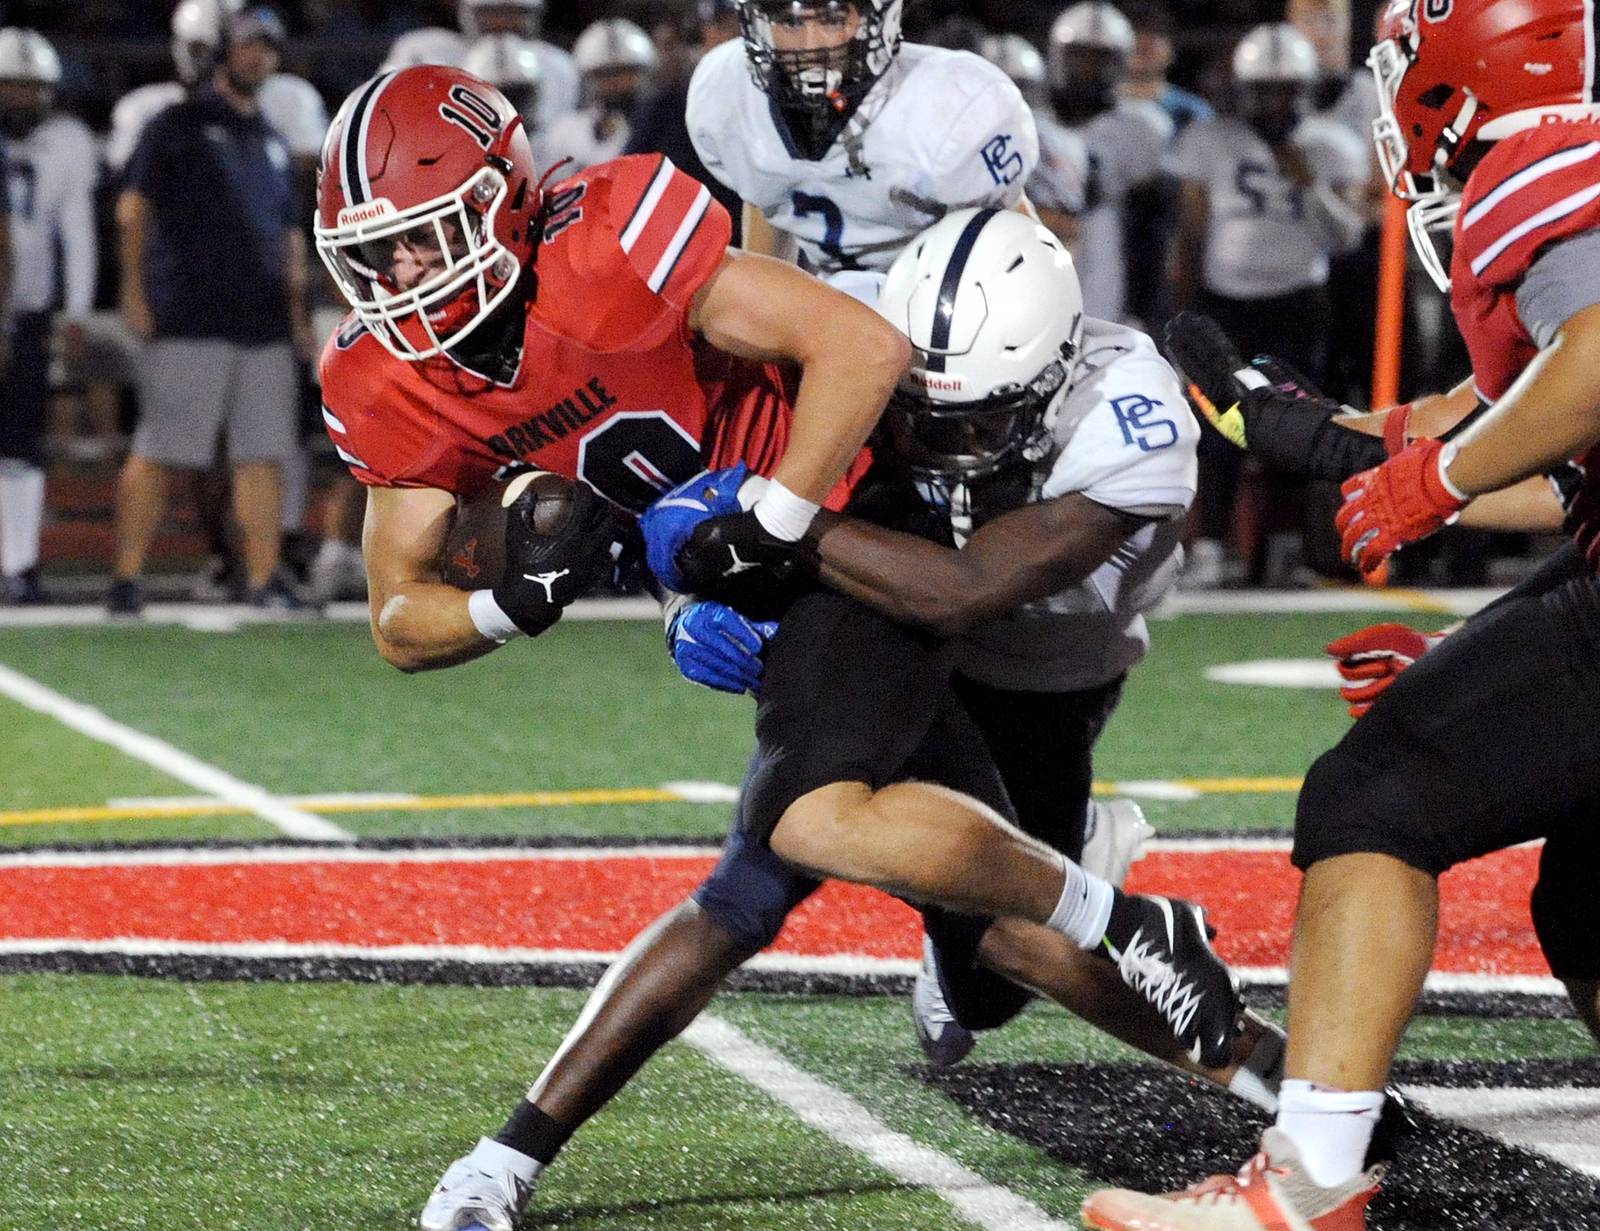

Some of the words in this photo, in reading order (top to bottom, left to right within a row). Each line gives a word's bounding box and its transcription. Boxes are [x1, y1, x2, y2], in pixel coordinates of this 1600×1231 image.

[438, 84, 502, 152] 10
[980, 134, 1024, 186] PS
[340, 203, 386, 225] Riddell
[487, 376, 618, 459] ORKVILLE
[1110, 393, 1178, 452] PS
